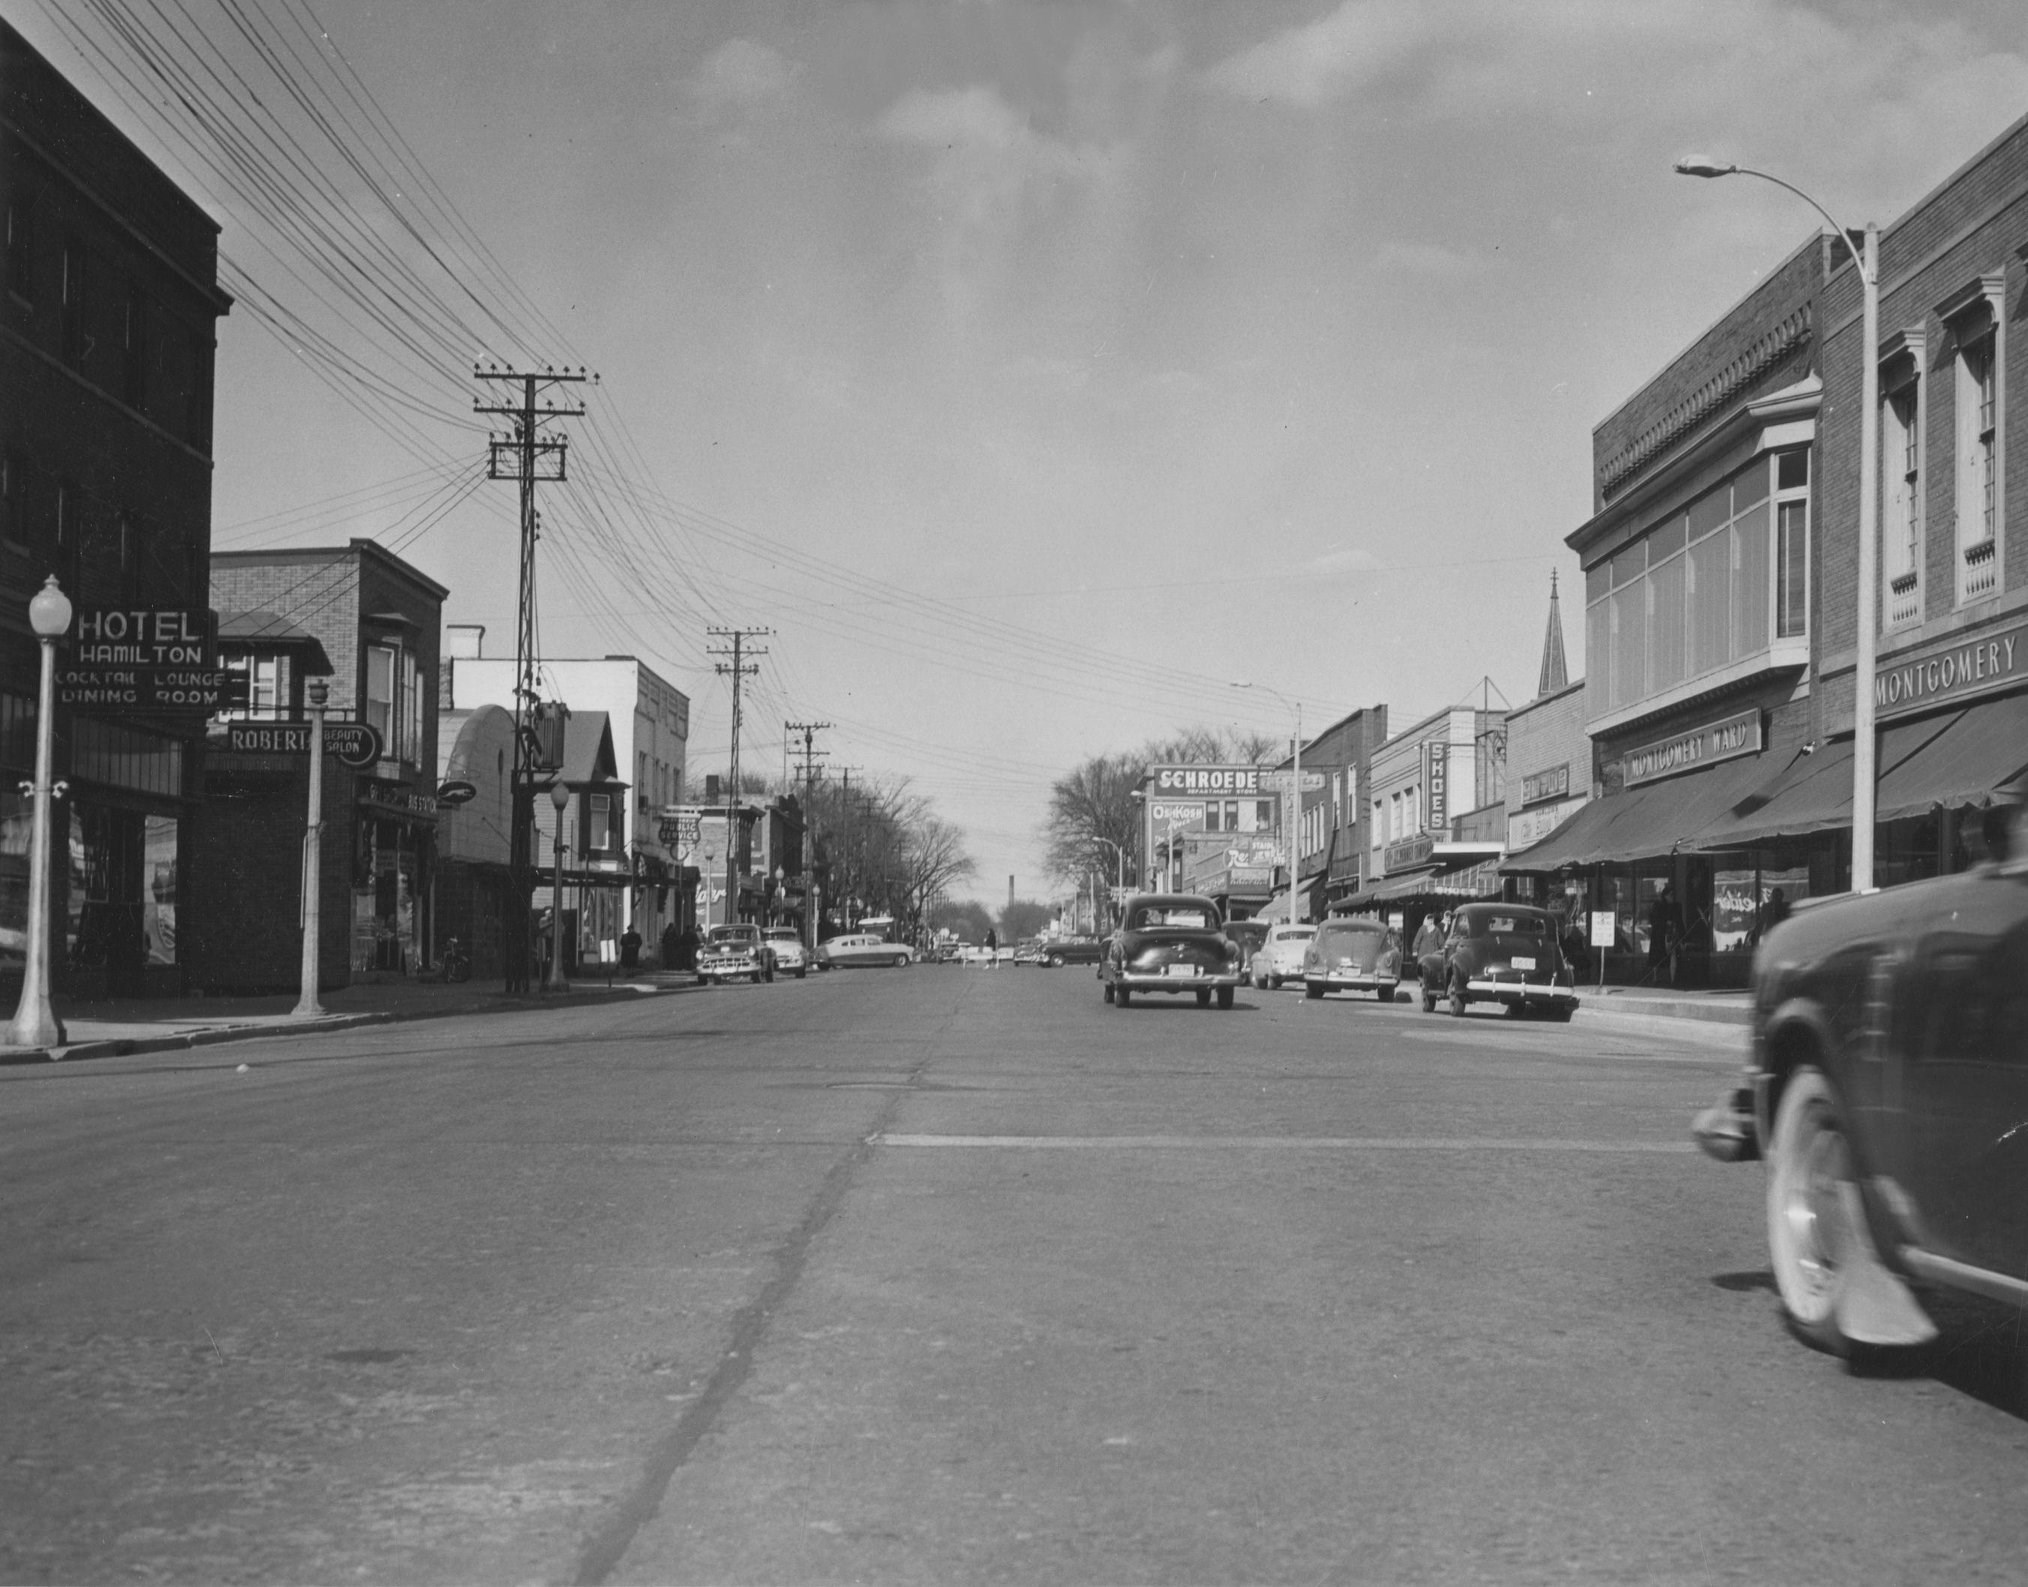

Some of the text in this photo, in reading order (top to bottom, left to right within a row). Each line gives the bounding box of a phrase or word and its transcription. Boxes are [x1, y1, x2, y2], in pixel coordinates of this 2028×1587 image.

[78, 611, 201, 641] HOTEL
[80, 645, 201, 664] HAMILTON
[55, 672, 225, 686] COCKTAIL LOUNGE
[1875, 636, 2016, 706] MONTGOMERY
[61, 690, 218, 704] DINING ROOM
[231, 730, 312, 751] ROBERT
[324, 730, 363, 741] BEAUTY
[326, 742, 360, 752] SALON
[1631, 722, 1746, 777] MONTGOMERY WARD
[1159, 770, 1267, 788] SCHROEDE
[1431, 744, 1444, 829] SHOES
[660, 832, 699, 840] SERVICE
[664, 823, 697, 831] PUBLIC
